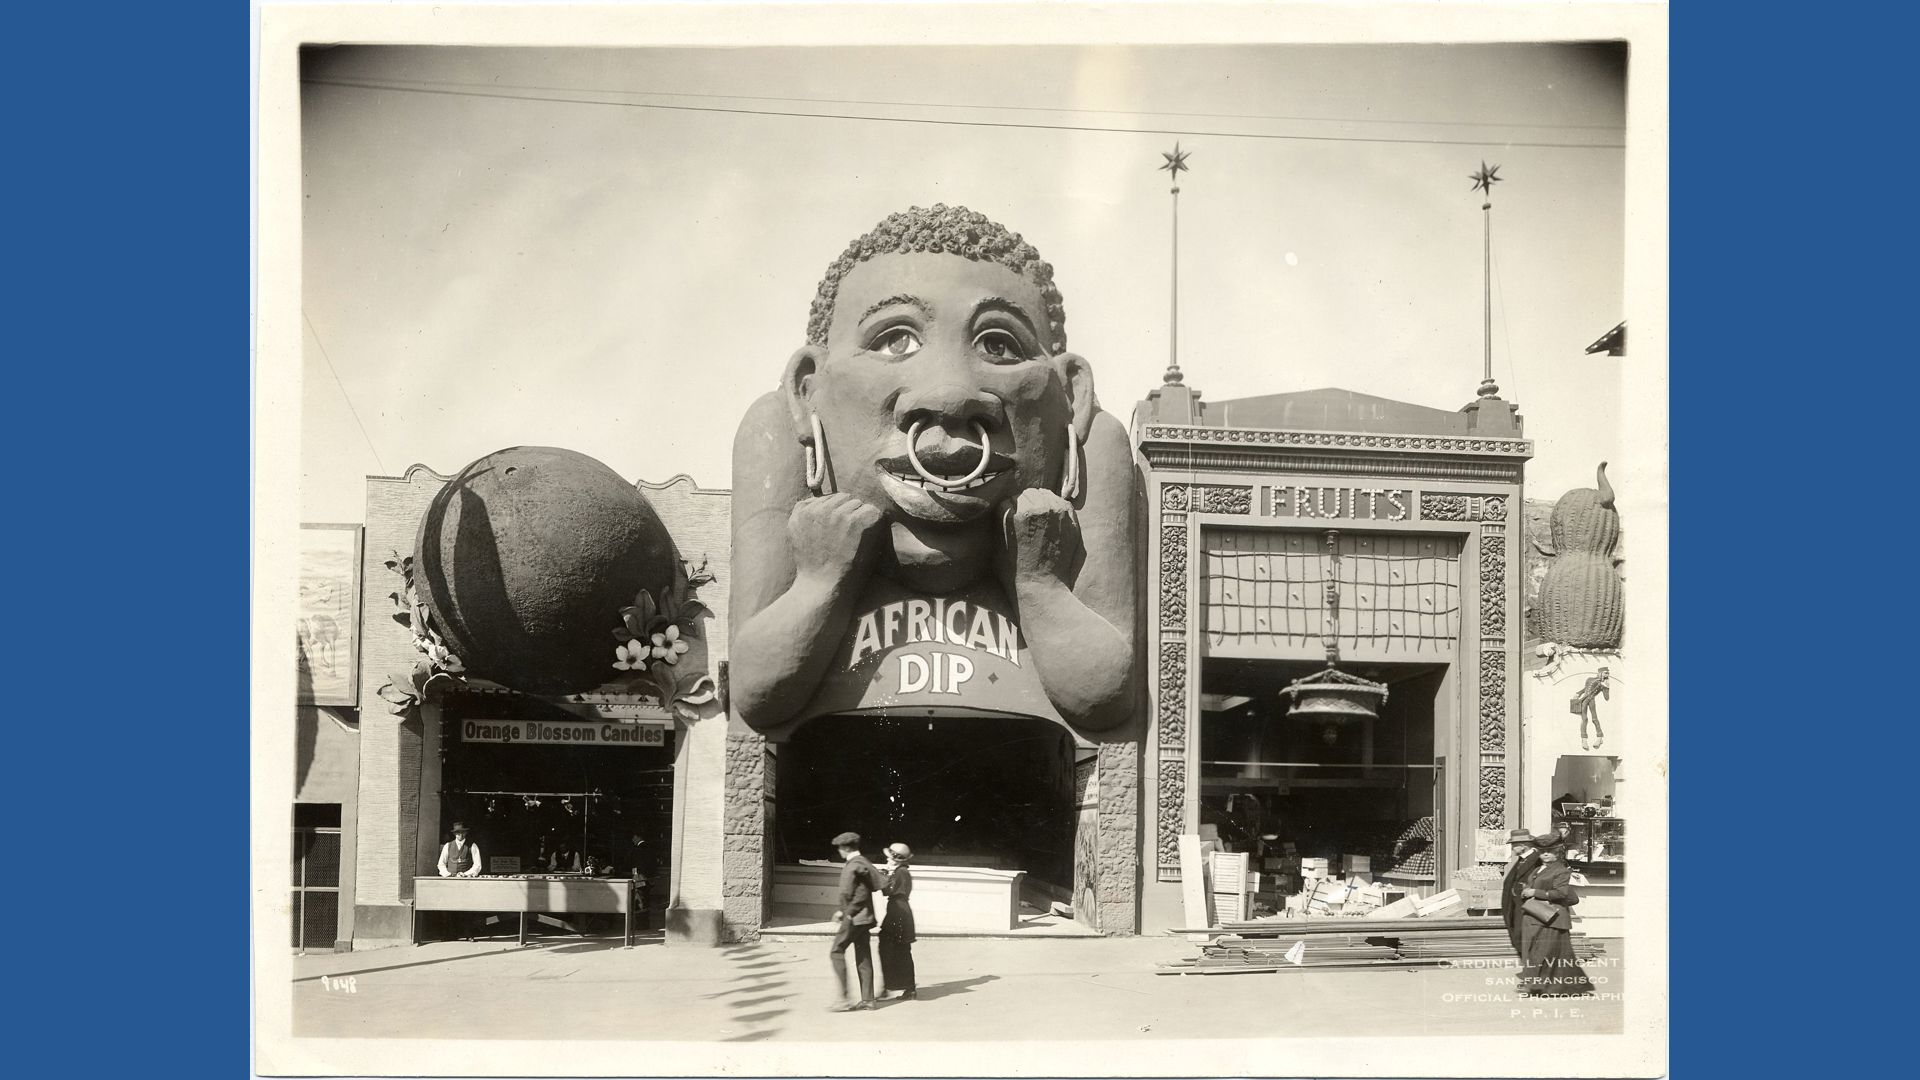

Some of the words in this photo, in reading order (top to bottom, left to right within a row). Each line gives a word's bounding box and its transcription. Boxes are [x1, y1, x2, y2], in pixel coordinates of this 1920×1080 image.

[1270, 485, 1406, 521] FRUITS
[848, 597, 1021, 669] AFRICAN
[895, 651, 974, 695] DIP
[464, 721, 521, 743] Orange
[526, 722, 596, 741] Blossom
[600, 724, 662, 743] Candies
